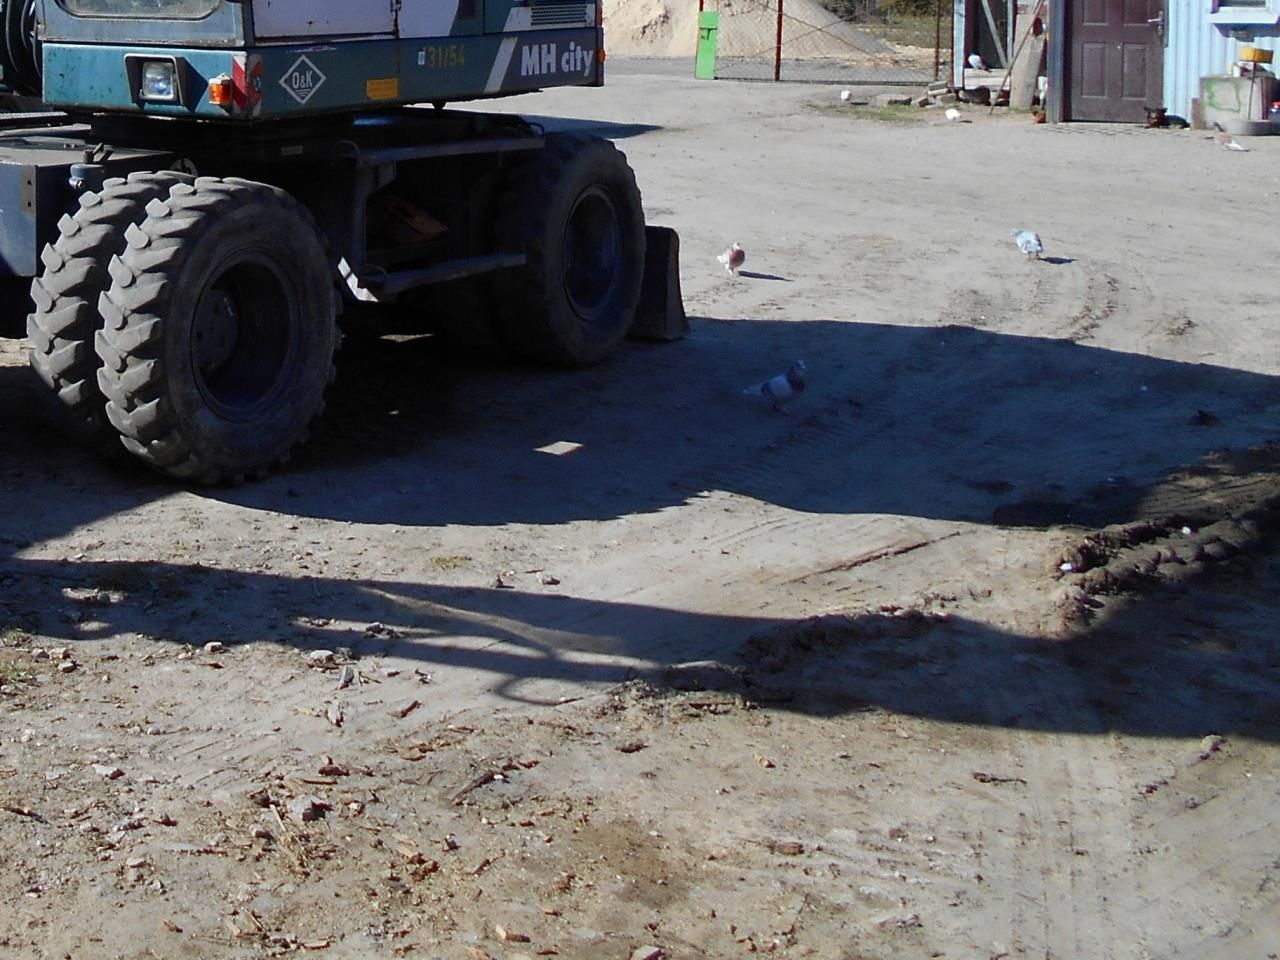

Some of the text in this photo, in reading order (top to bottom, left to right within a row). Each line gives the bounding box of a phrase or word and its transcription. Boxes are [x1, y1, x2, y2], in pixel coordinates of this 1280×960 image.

[520, 41, 594, 77] MH city
[291, 70, 313, 89] O&K
